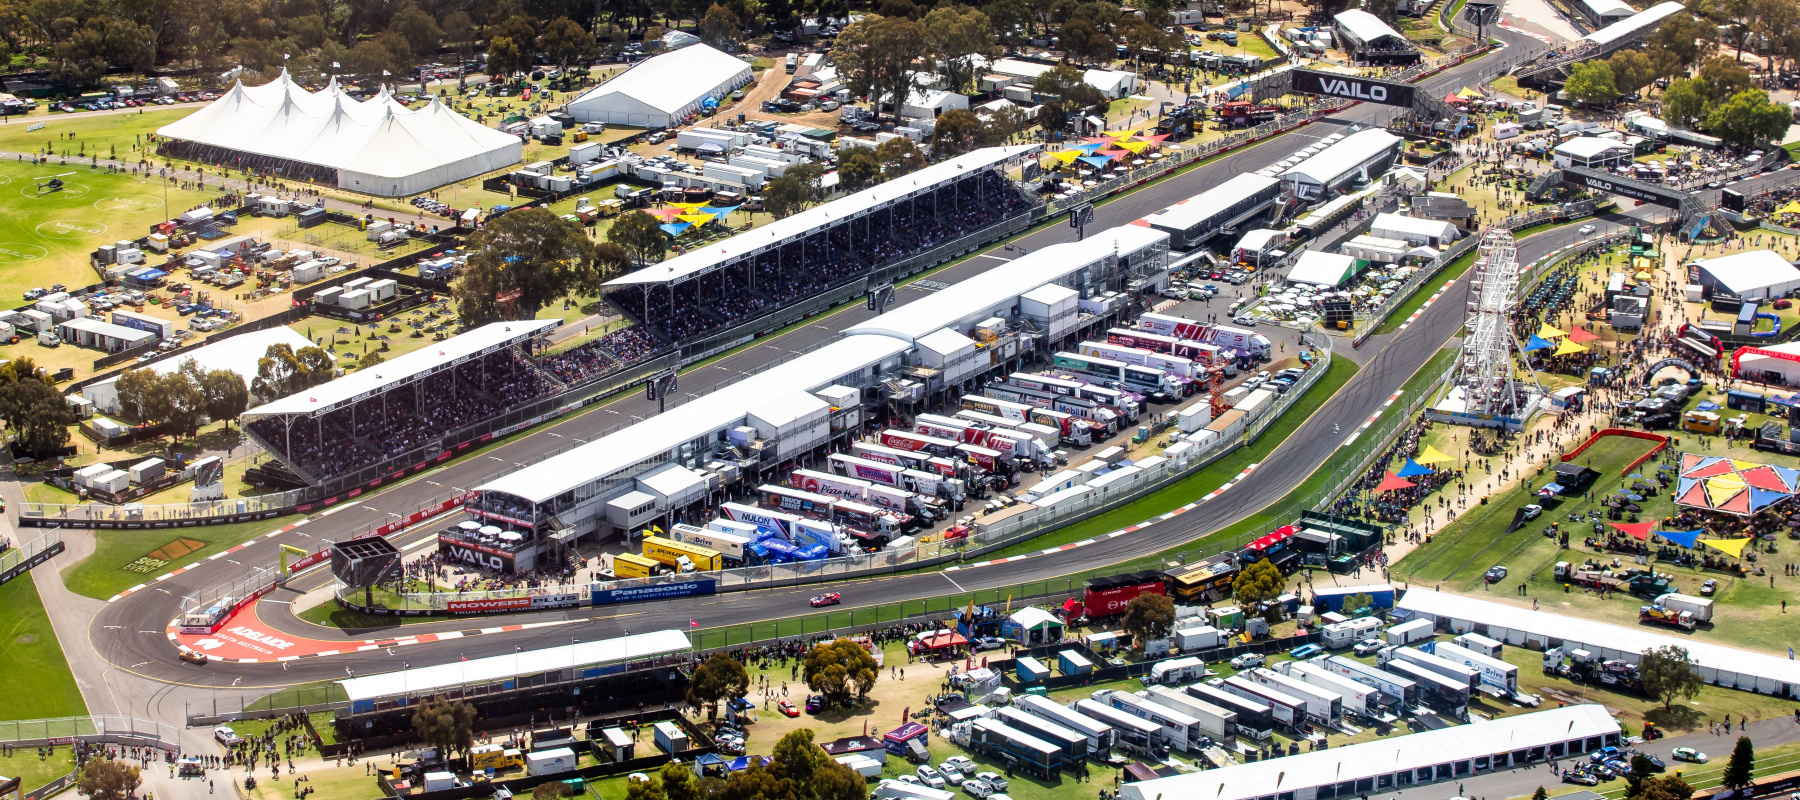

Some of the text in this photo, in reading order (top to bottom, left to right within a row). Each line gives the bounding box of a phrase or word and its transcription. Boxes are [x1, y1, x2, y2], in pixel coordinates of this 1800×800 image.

[1318, 77, 1387, 102] VAILO
[1585, 178, 1612, 190] VAILO
[997, 392, 1016, 401] OPTUS
[1059, 404, 1080, 416] Mobil
[821, 484, 860, 499] Pizza Hut
[780, 501, 800, 510] ASSIST
[781, 496, 800, 504] TRUCK
[742, 513, 770, 525] NULON
[684, 534, 713, 545] CoolDrive
[135, 557, 169, 568] SIGN
[450, 546, 503, 570] VAILO
[611, 583, 698, 597] Panasonic
[633, 590, 692, 600] CONDITIONING
[450, 595, 577, 608] MOWERS PLUS
[214, 632, 274, 655] SOUTH AUSTRALIA
[227, 626, 295, 650] ADELAIDE
